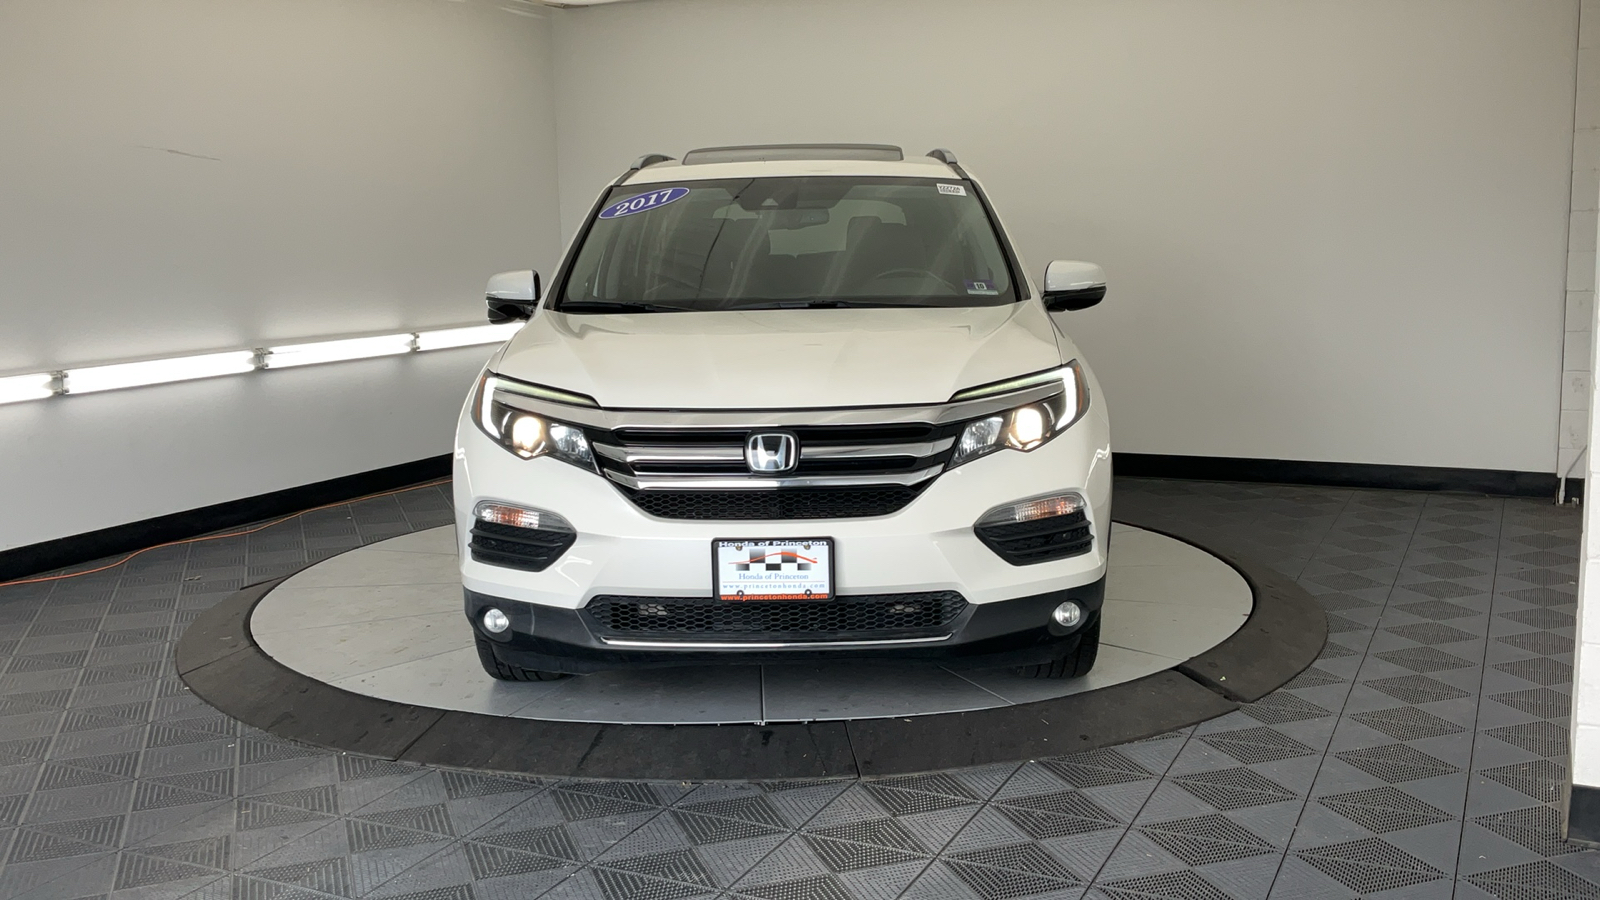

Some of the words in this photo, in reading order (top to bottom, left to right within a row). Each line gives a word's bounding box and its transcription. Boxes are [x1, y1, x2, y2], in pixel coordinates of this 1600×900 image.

[614, 189, 673, 216] 2017
[719, 540, 755, 548] Honda
[764, 572, 773, 580] of
[774, 572, 809, 580] Princeton
[720, 593, 828, 601] www.princetonhonda.com
